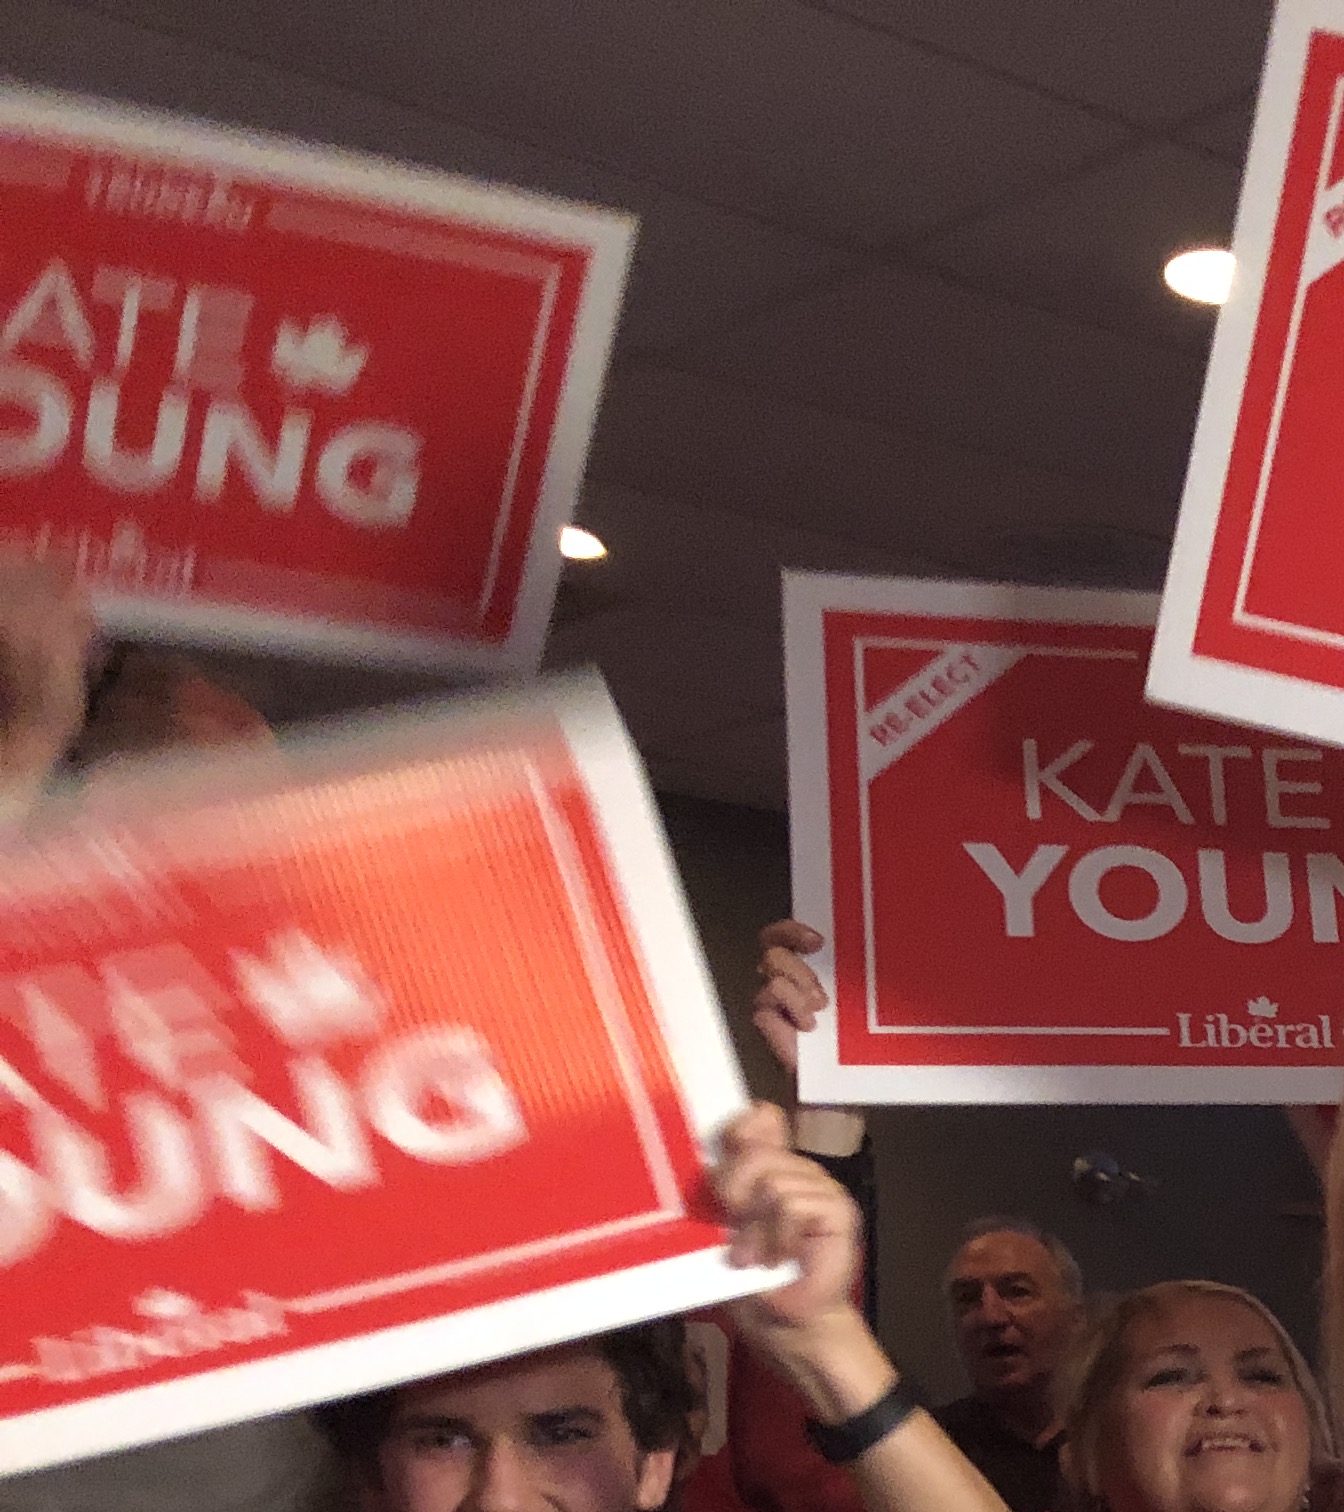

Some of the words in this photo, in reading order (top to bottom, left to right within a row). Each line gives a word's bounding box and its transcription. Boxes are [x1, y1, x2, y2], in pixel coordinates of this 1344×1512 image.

[0, 255, 255, 396] ATE
[0, 360, 425, 529] OUNG
[869, 653, 980, 747] RE-ELECT
[1020, 737, 1331, 829] KATE
[1176, 1012, 1335, 1050] Liberal
